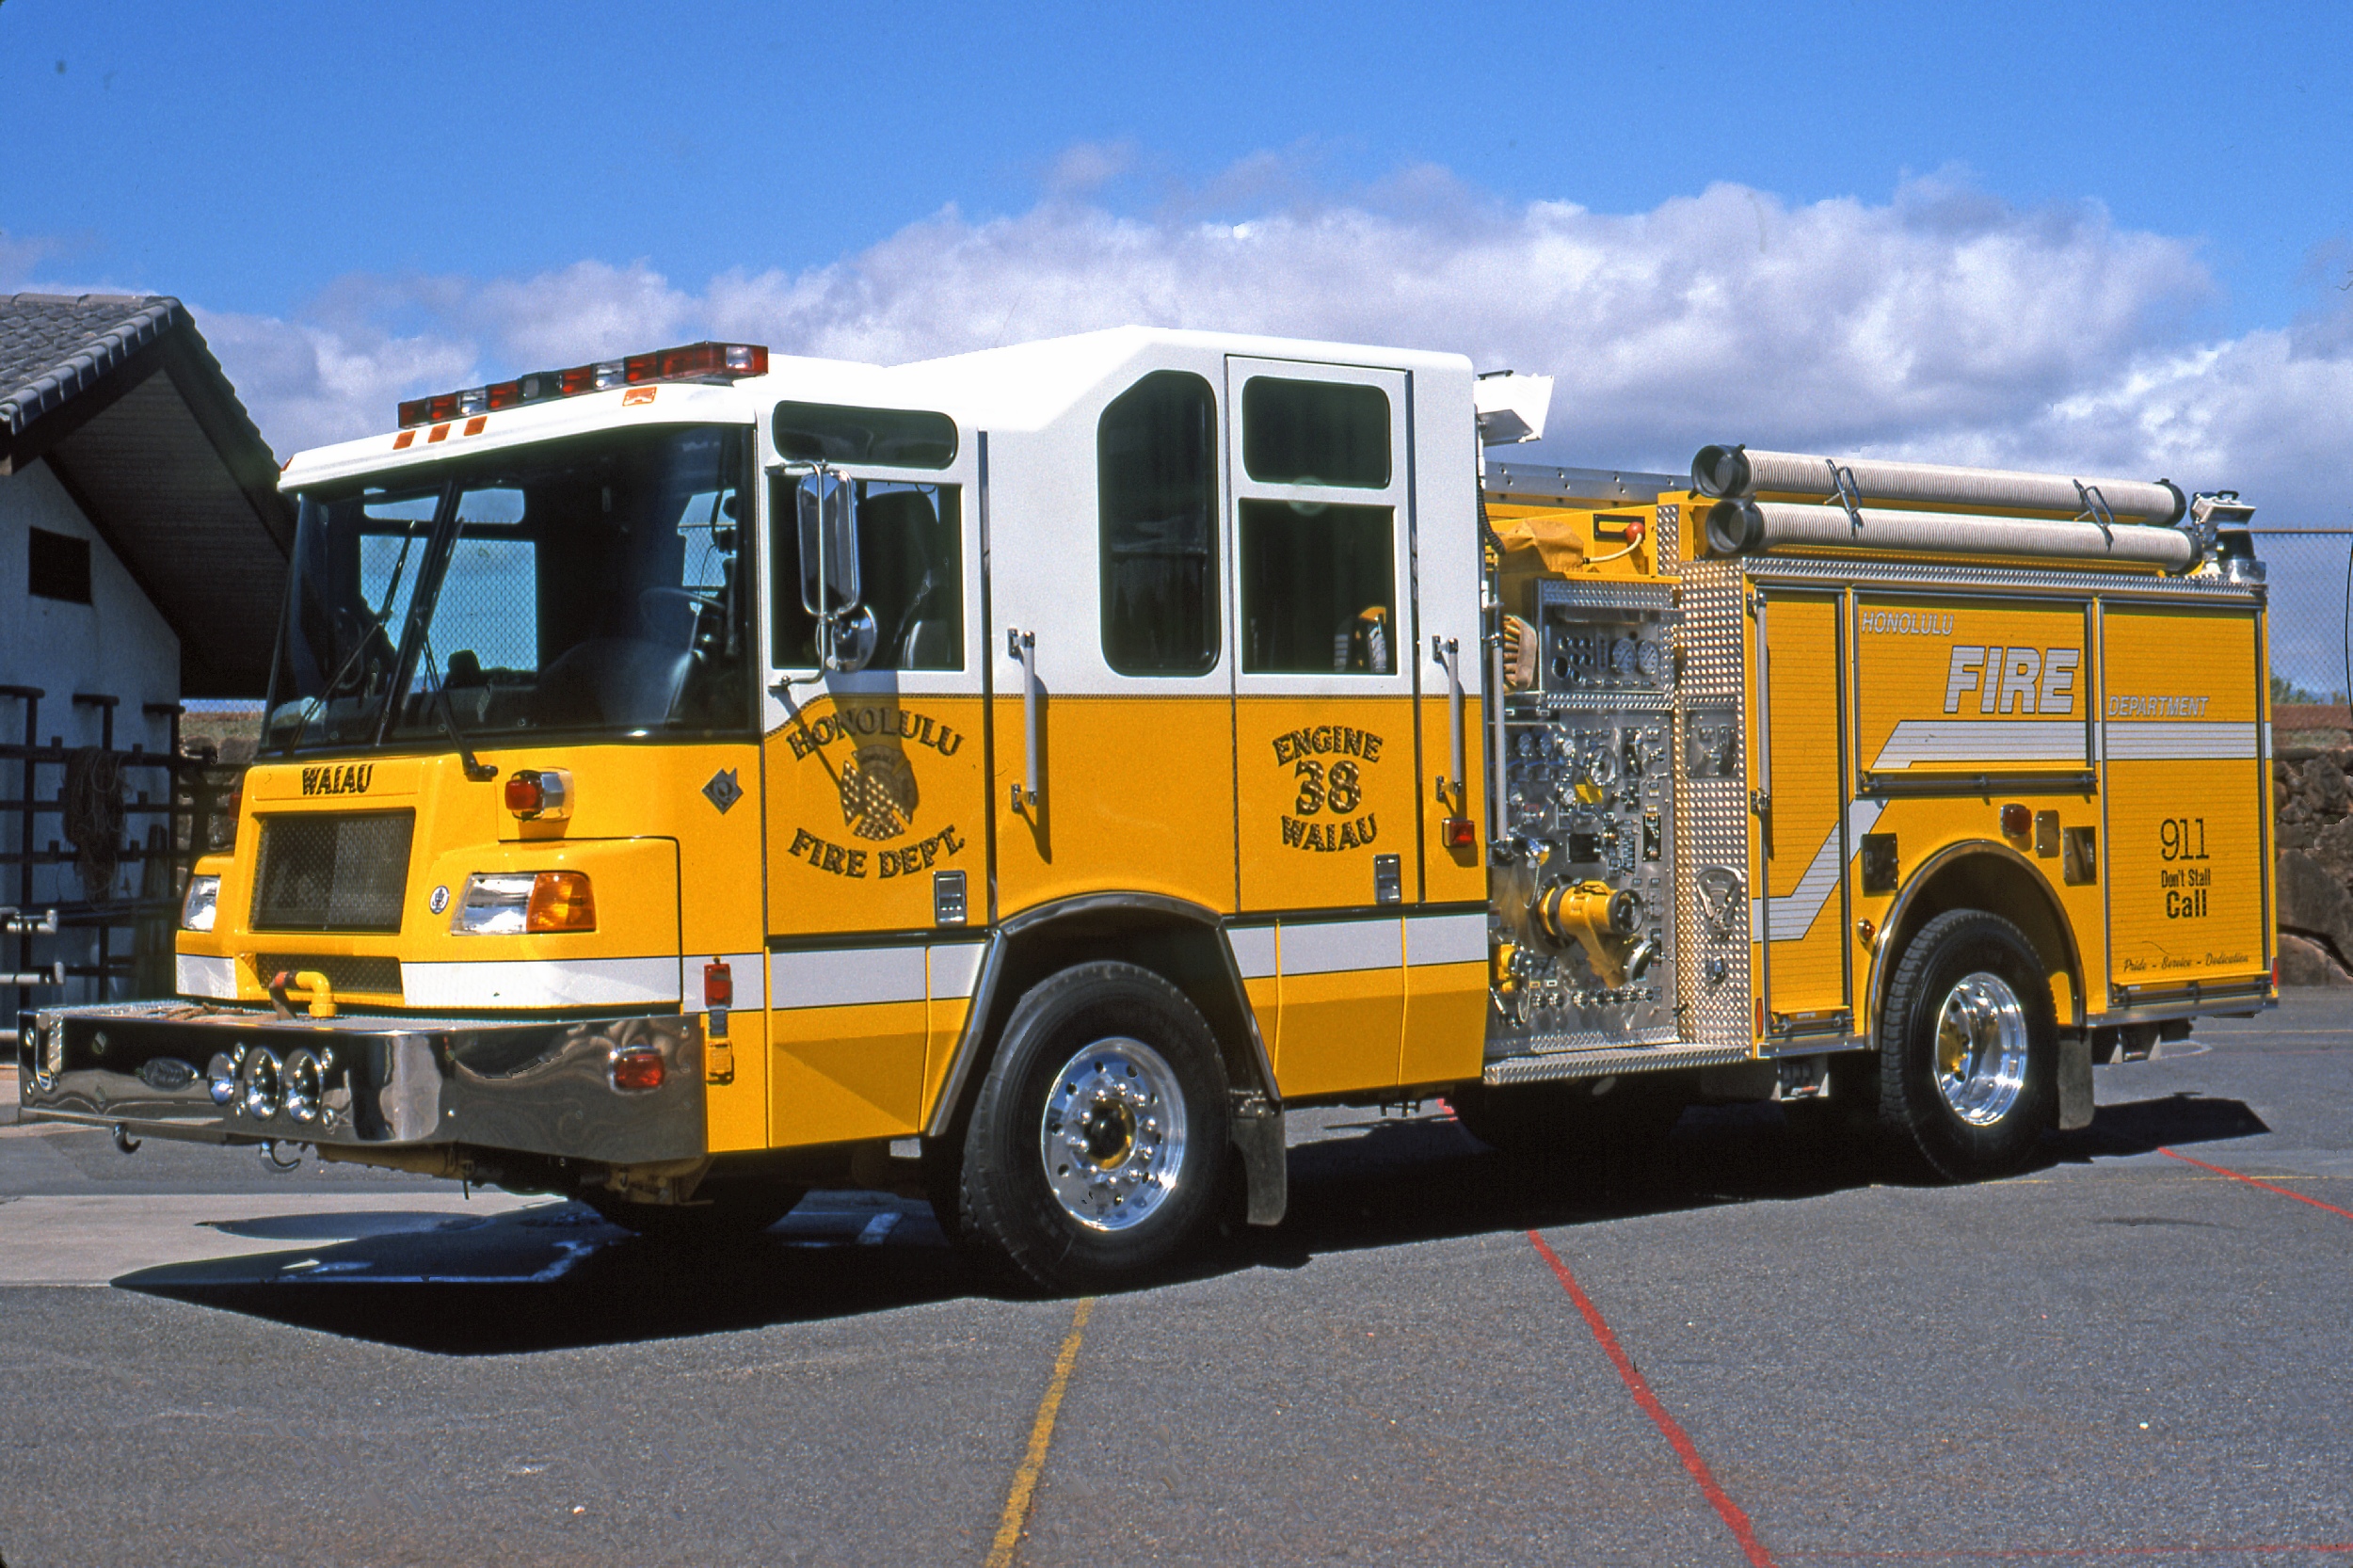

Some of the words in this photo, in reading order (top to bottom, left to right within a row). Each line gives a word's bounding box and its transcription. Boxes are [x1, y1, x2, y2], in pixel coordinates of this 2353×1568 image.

[1862, 612, 1954, 636] HONOLULU
[1944, 646, 2080, 714] FIRE
[2107, 696, 2209, 718] DEPARTMENT
[786, 707, 966, 762] HONOLULU
[1272, 725, 1383, 767] ENGINE
[302, 763, 375, 795] WAIAU
[1294, 759, 1362, 816] 38
[787, 827, 868, 879] FIRE
[878, 824, 966, 879] DEPT.
[1281, 812, 1378, 853] WAIAU
[2160, 817, 2210, 861] 911
[2161, 869, 2185, 888] Don't
[2187, 867, 2212, 888] Stall
[2167, 889, 2207, 919] Call
[2123, 958, 2147, 973] Pride
[2161, 956, 2193, 970] Service
[2205, 952, 2249, 968] Dedication
